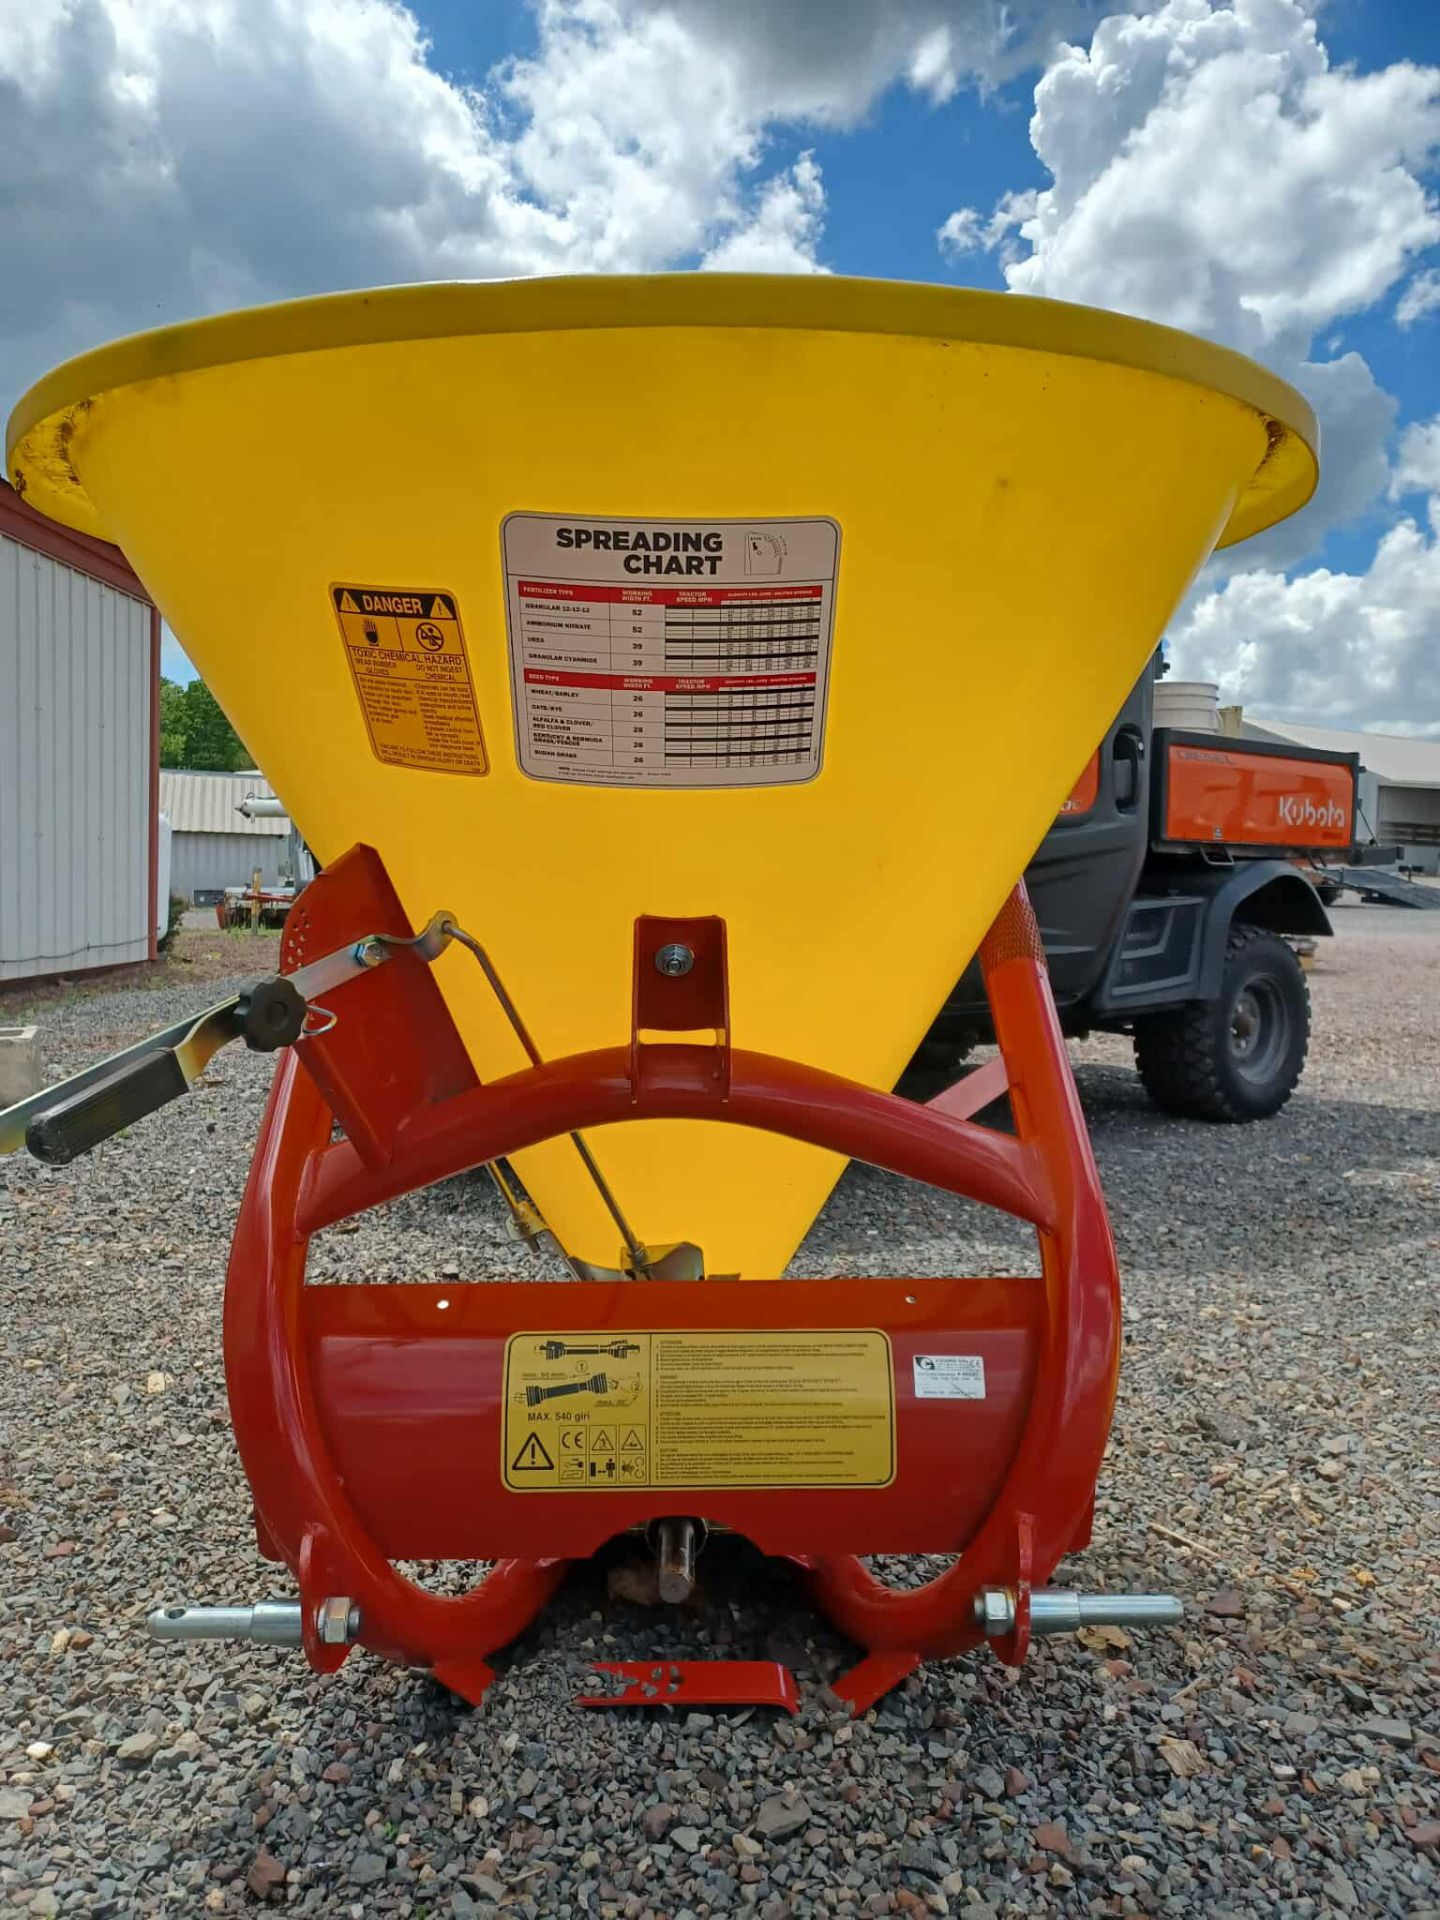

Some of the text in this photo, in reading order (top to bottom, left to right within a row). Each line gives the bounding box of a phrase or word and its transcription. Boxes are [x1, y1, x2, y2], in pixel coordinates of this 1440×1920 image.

[556, 527, 723, 552] SPREADING
[623, 555, 723, 575] CHART
[523, 586, 574, 596] FERTILIZER TYPE
[362, 595, 423, 614] DANGER
[525, 602, 560, 611] GRANULAR
[526, 620, 592, 630] AMMONIUM NITRATE
[527, 636, 545, 644] UREA
[352, 647, 462, 665] TOXIC CHEMICAL HAZARD
[528, 652, 563, 661] GRANULAR
[531, 688, 579, 698] WHEAT/BARLEY
[533, 716, 559, 724] ALFALFA
[533, 732, 566, 740] KENTUCKY
[1279, 796, 1345, 828] Kubota
[527, 1411, 590, 1423] MAX. 540 giri
